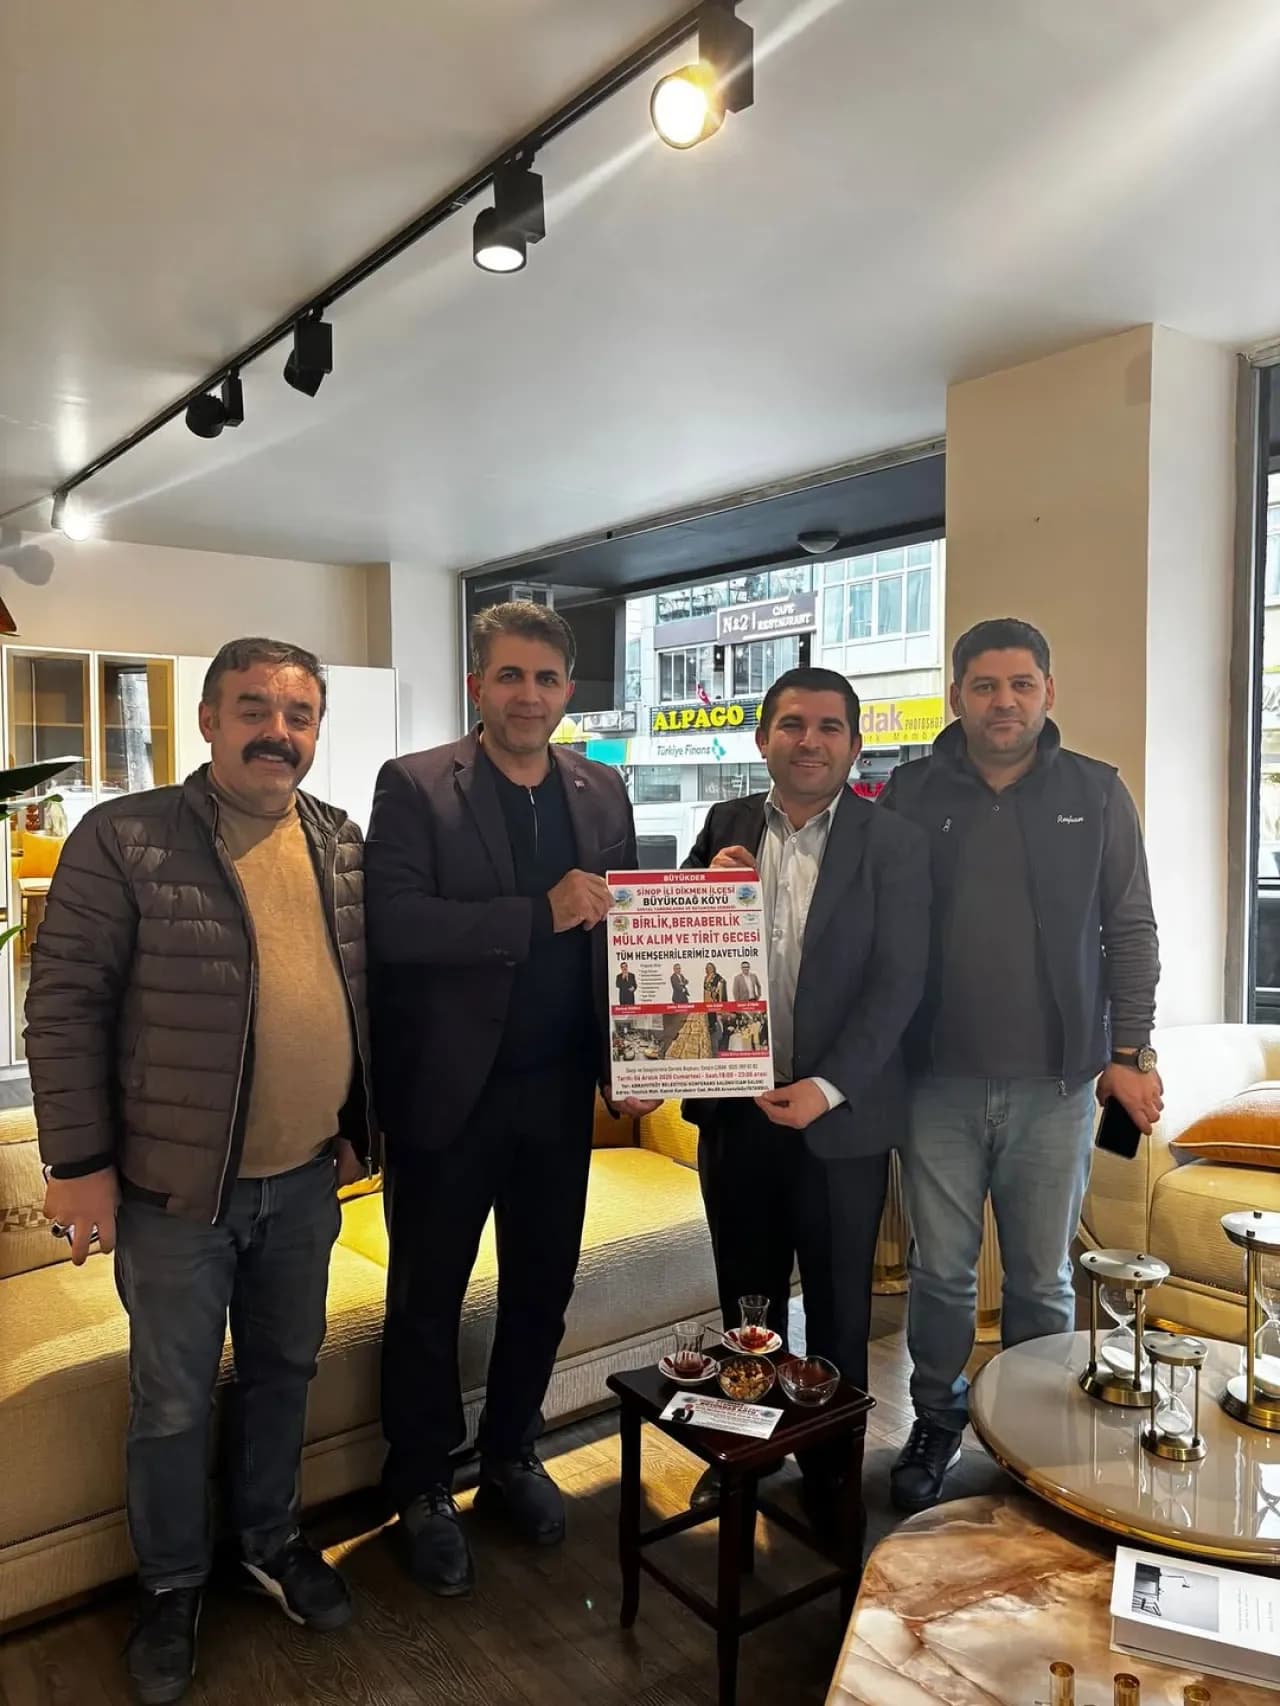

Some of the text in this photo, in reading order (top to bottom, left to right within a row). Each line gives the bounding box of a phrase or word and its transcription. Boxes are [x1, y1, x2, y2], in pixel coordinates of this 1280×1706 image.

[772, 603, 797, 615] CAFE
[653, 705, 744, 731] ALPAGO
[861, 704, 903, 733] dak
[657, 744, 711, 758] Türkiye Finans
[663, 874, 706, 882] BÜYÜKDER
[636, 887, 662, 897] SİNOP
[674, 885, 708, 895] DİKMEN
[643, 895, 699, 906] BÜYÜKDAĞ
[613, 929, 761, 946] MÜLK ALIM VE TİRİT GECESİ
[616, 949, 634, 961] TÜM
[711, 945, 759, 959] DAVETLİDİR
